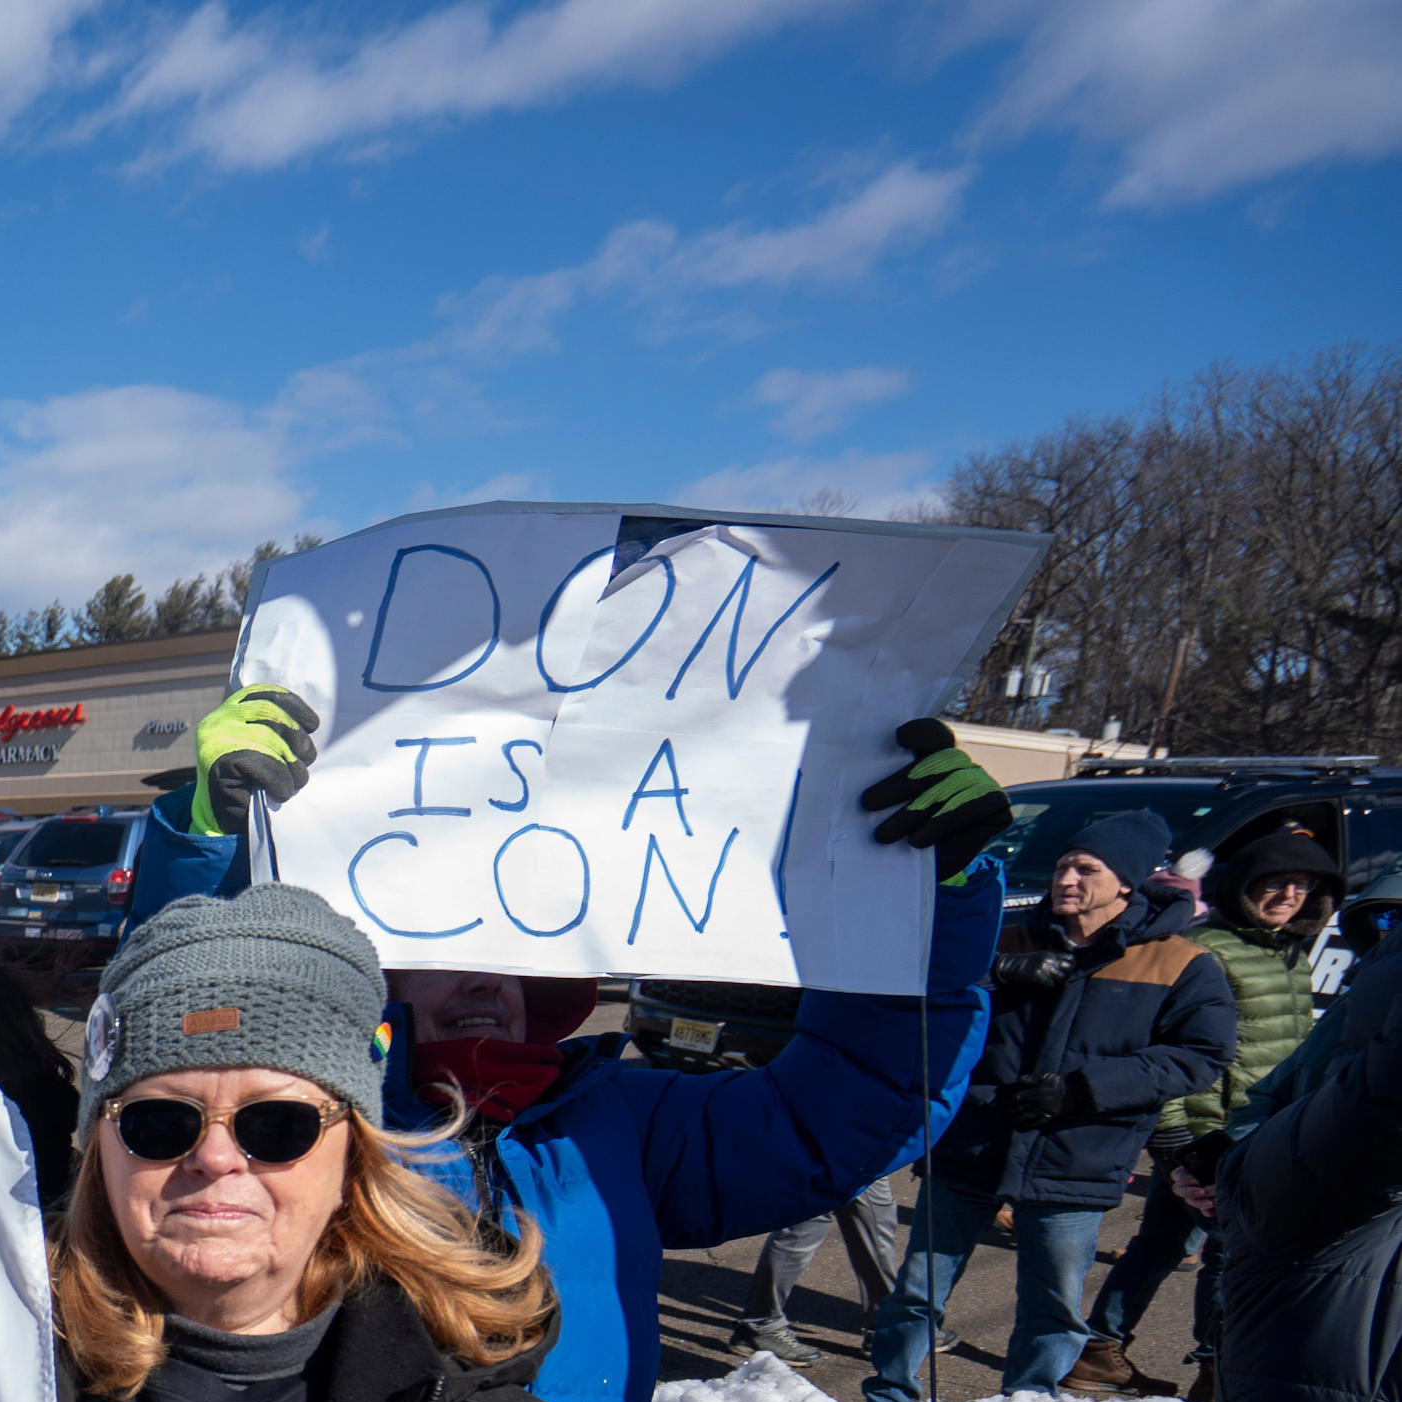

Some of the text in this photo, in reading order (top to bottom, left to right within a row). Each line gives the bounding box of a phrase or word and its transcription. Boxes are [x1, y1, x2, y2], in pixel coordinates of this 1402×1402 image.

[362, 543, 841, 701] DON
[147, 719, 187, 735] Photo
[388, 736, 694, 837] IS A
